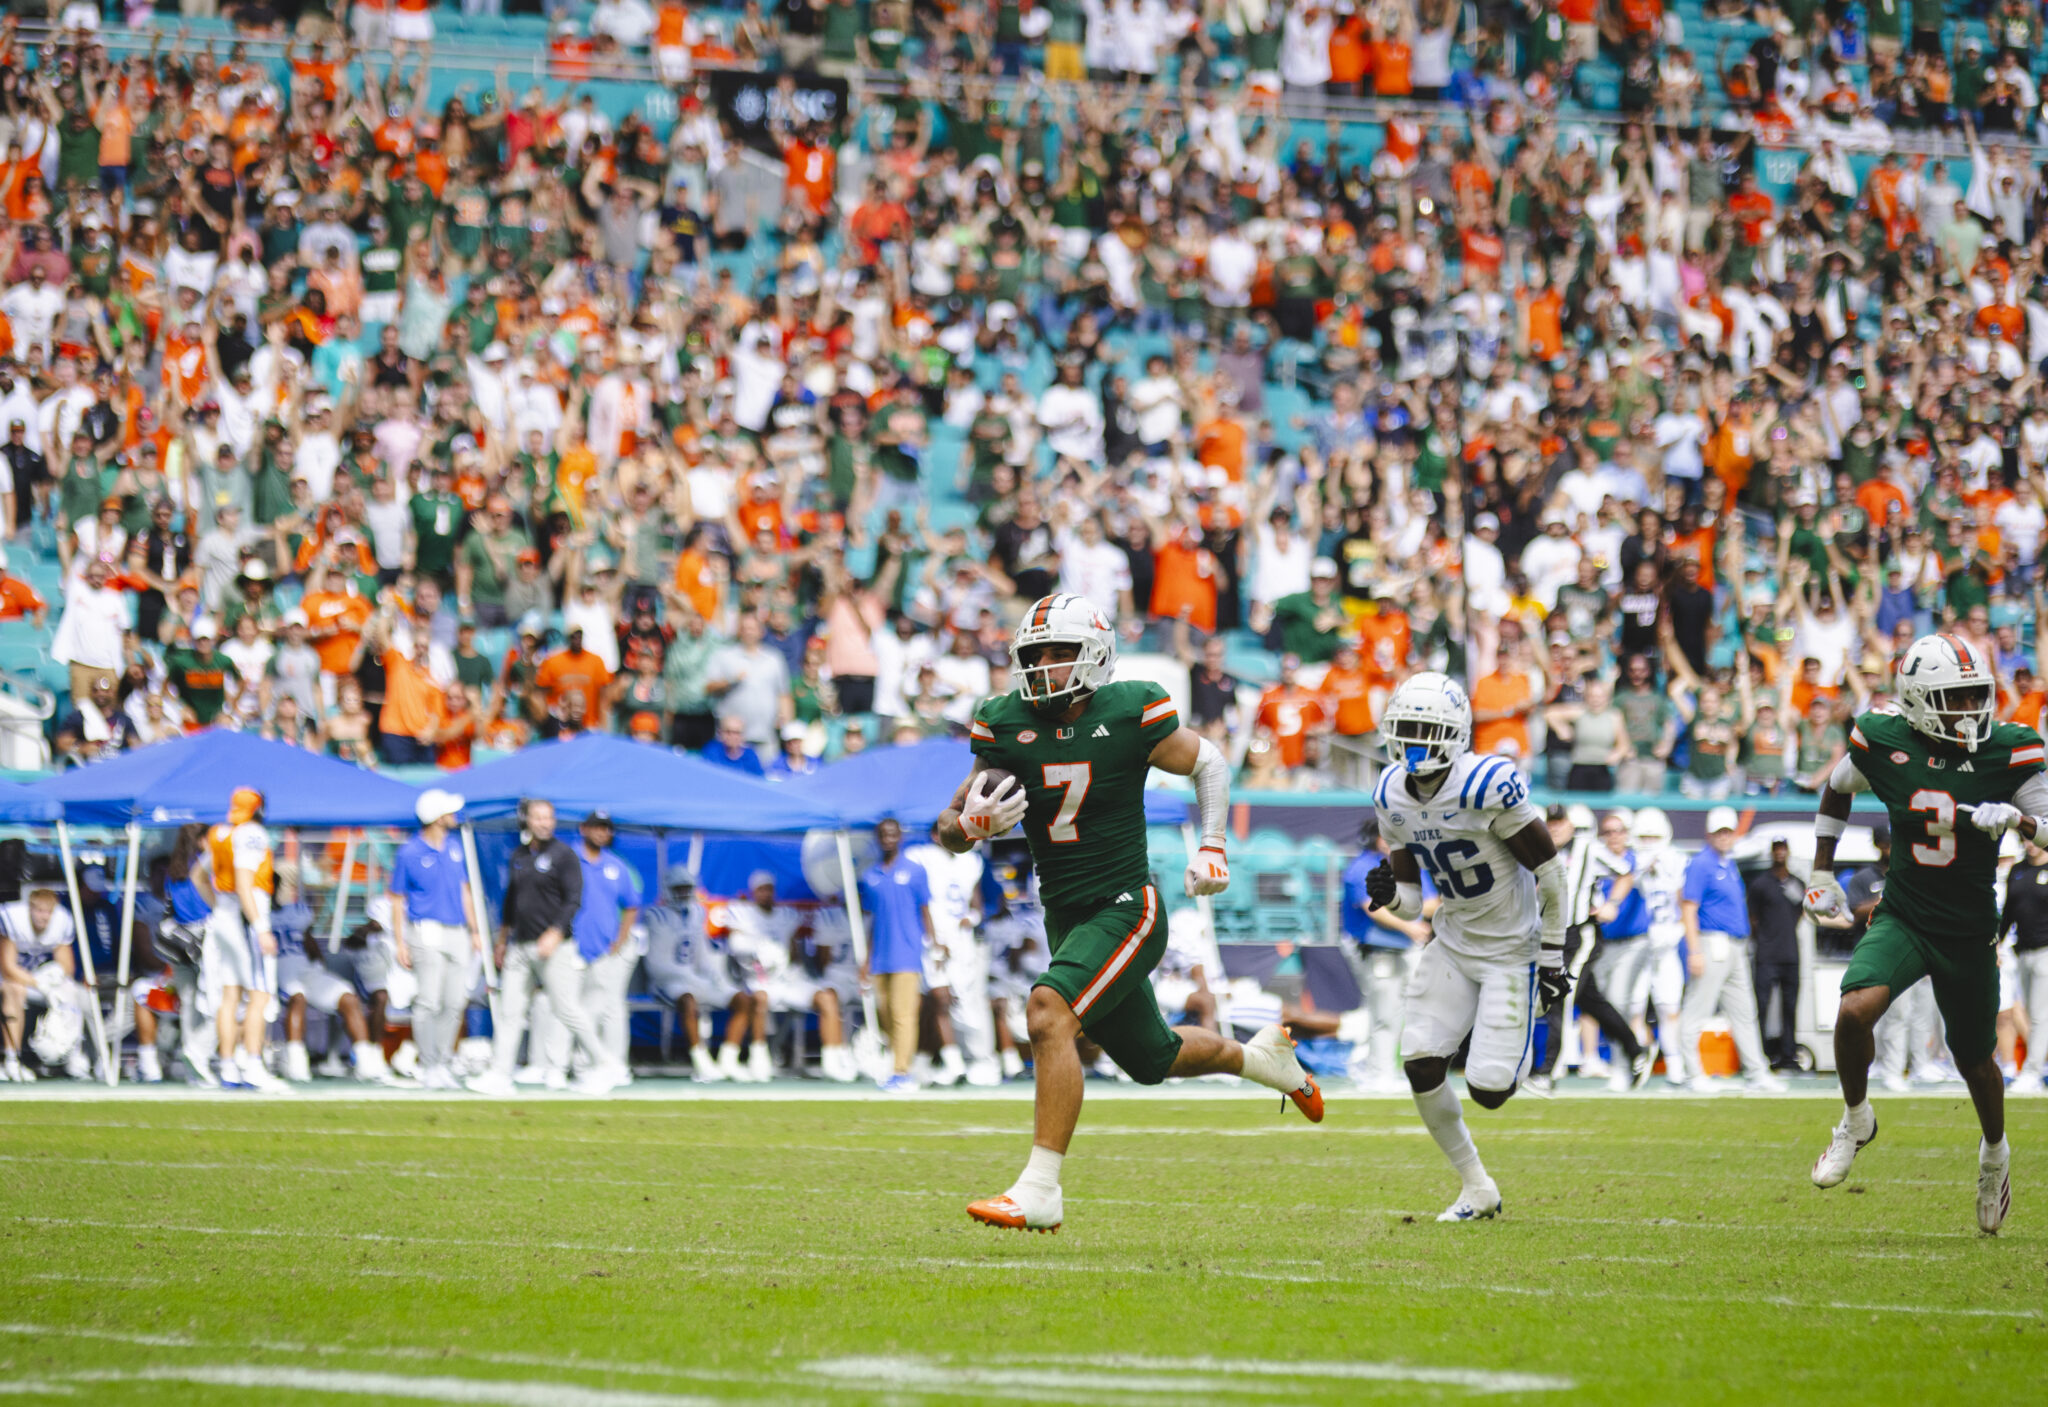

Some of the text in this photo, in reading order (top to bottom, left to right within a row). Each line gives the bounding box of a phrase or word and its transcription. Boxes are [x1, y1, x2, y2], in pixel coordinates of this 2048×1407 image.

[1960, 672, 1979, 680] MIAMI
[1056, 727, 1074, 740] U
[1927, 757, 1946, 769] U
[1041, 761, 1093, 843] 7
[1496, 771, 1526, 809] 26
[1413, 829, 1443, 842] DUKE
[1908, 788, 1957, 868] 3
[1405, 838, 1496, 899] 26
